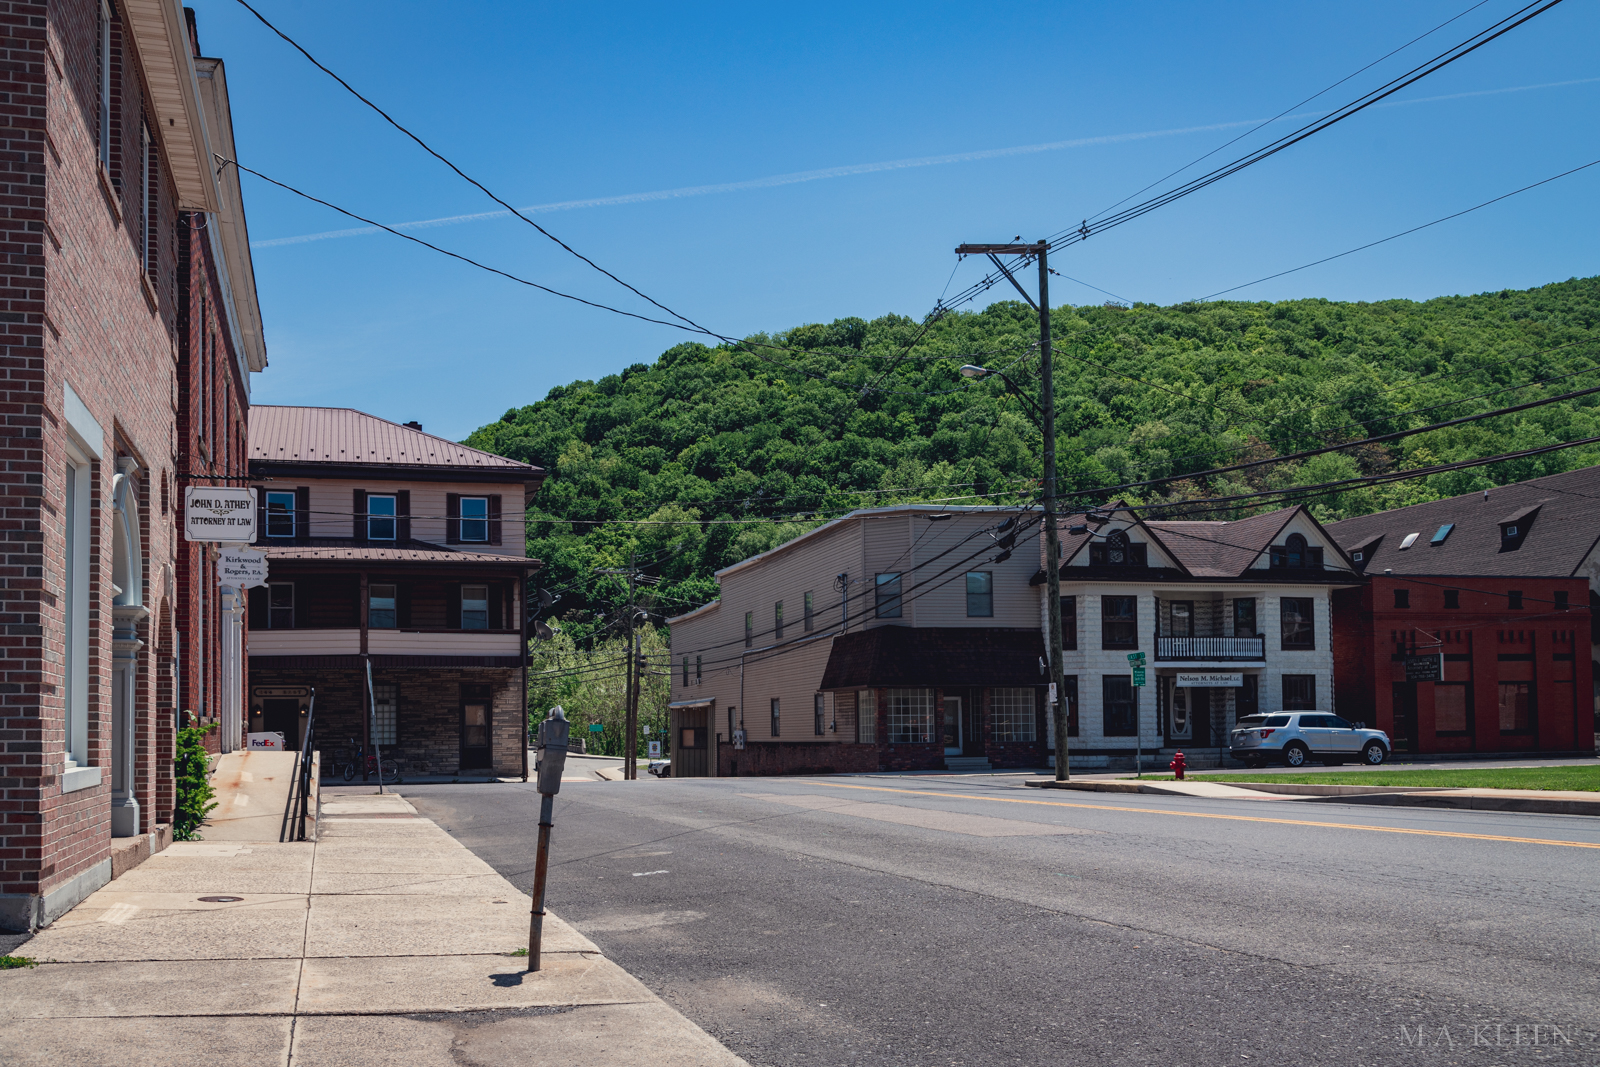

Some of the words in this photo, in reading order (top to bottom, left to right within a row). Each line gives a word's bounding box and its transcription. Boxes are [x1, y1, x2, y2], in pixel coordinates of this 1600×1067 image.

[189, 499, 212, 509] JOHN
[214, 499, 223, 509] D.
[224, 500, 251, 510] ATHEY
[190, 517, 226, 526] ATTORNEY
[227, 518, 235, 526] AT
[237, 518, 252, 526] LAW
[225, 556, 261, 564] Kirkwood
[224, 568, 251, 576] Rogers,
[251, 739, 275, 747] FedEx
